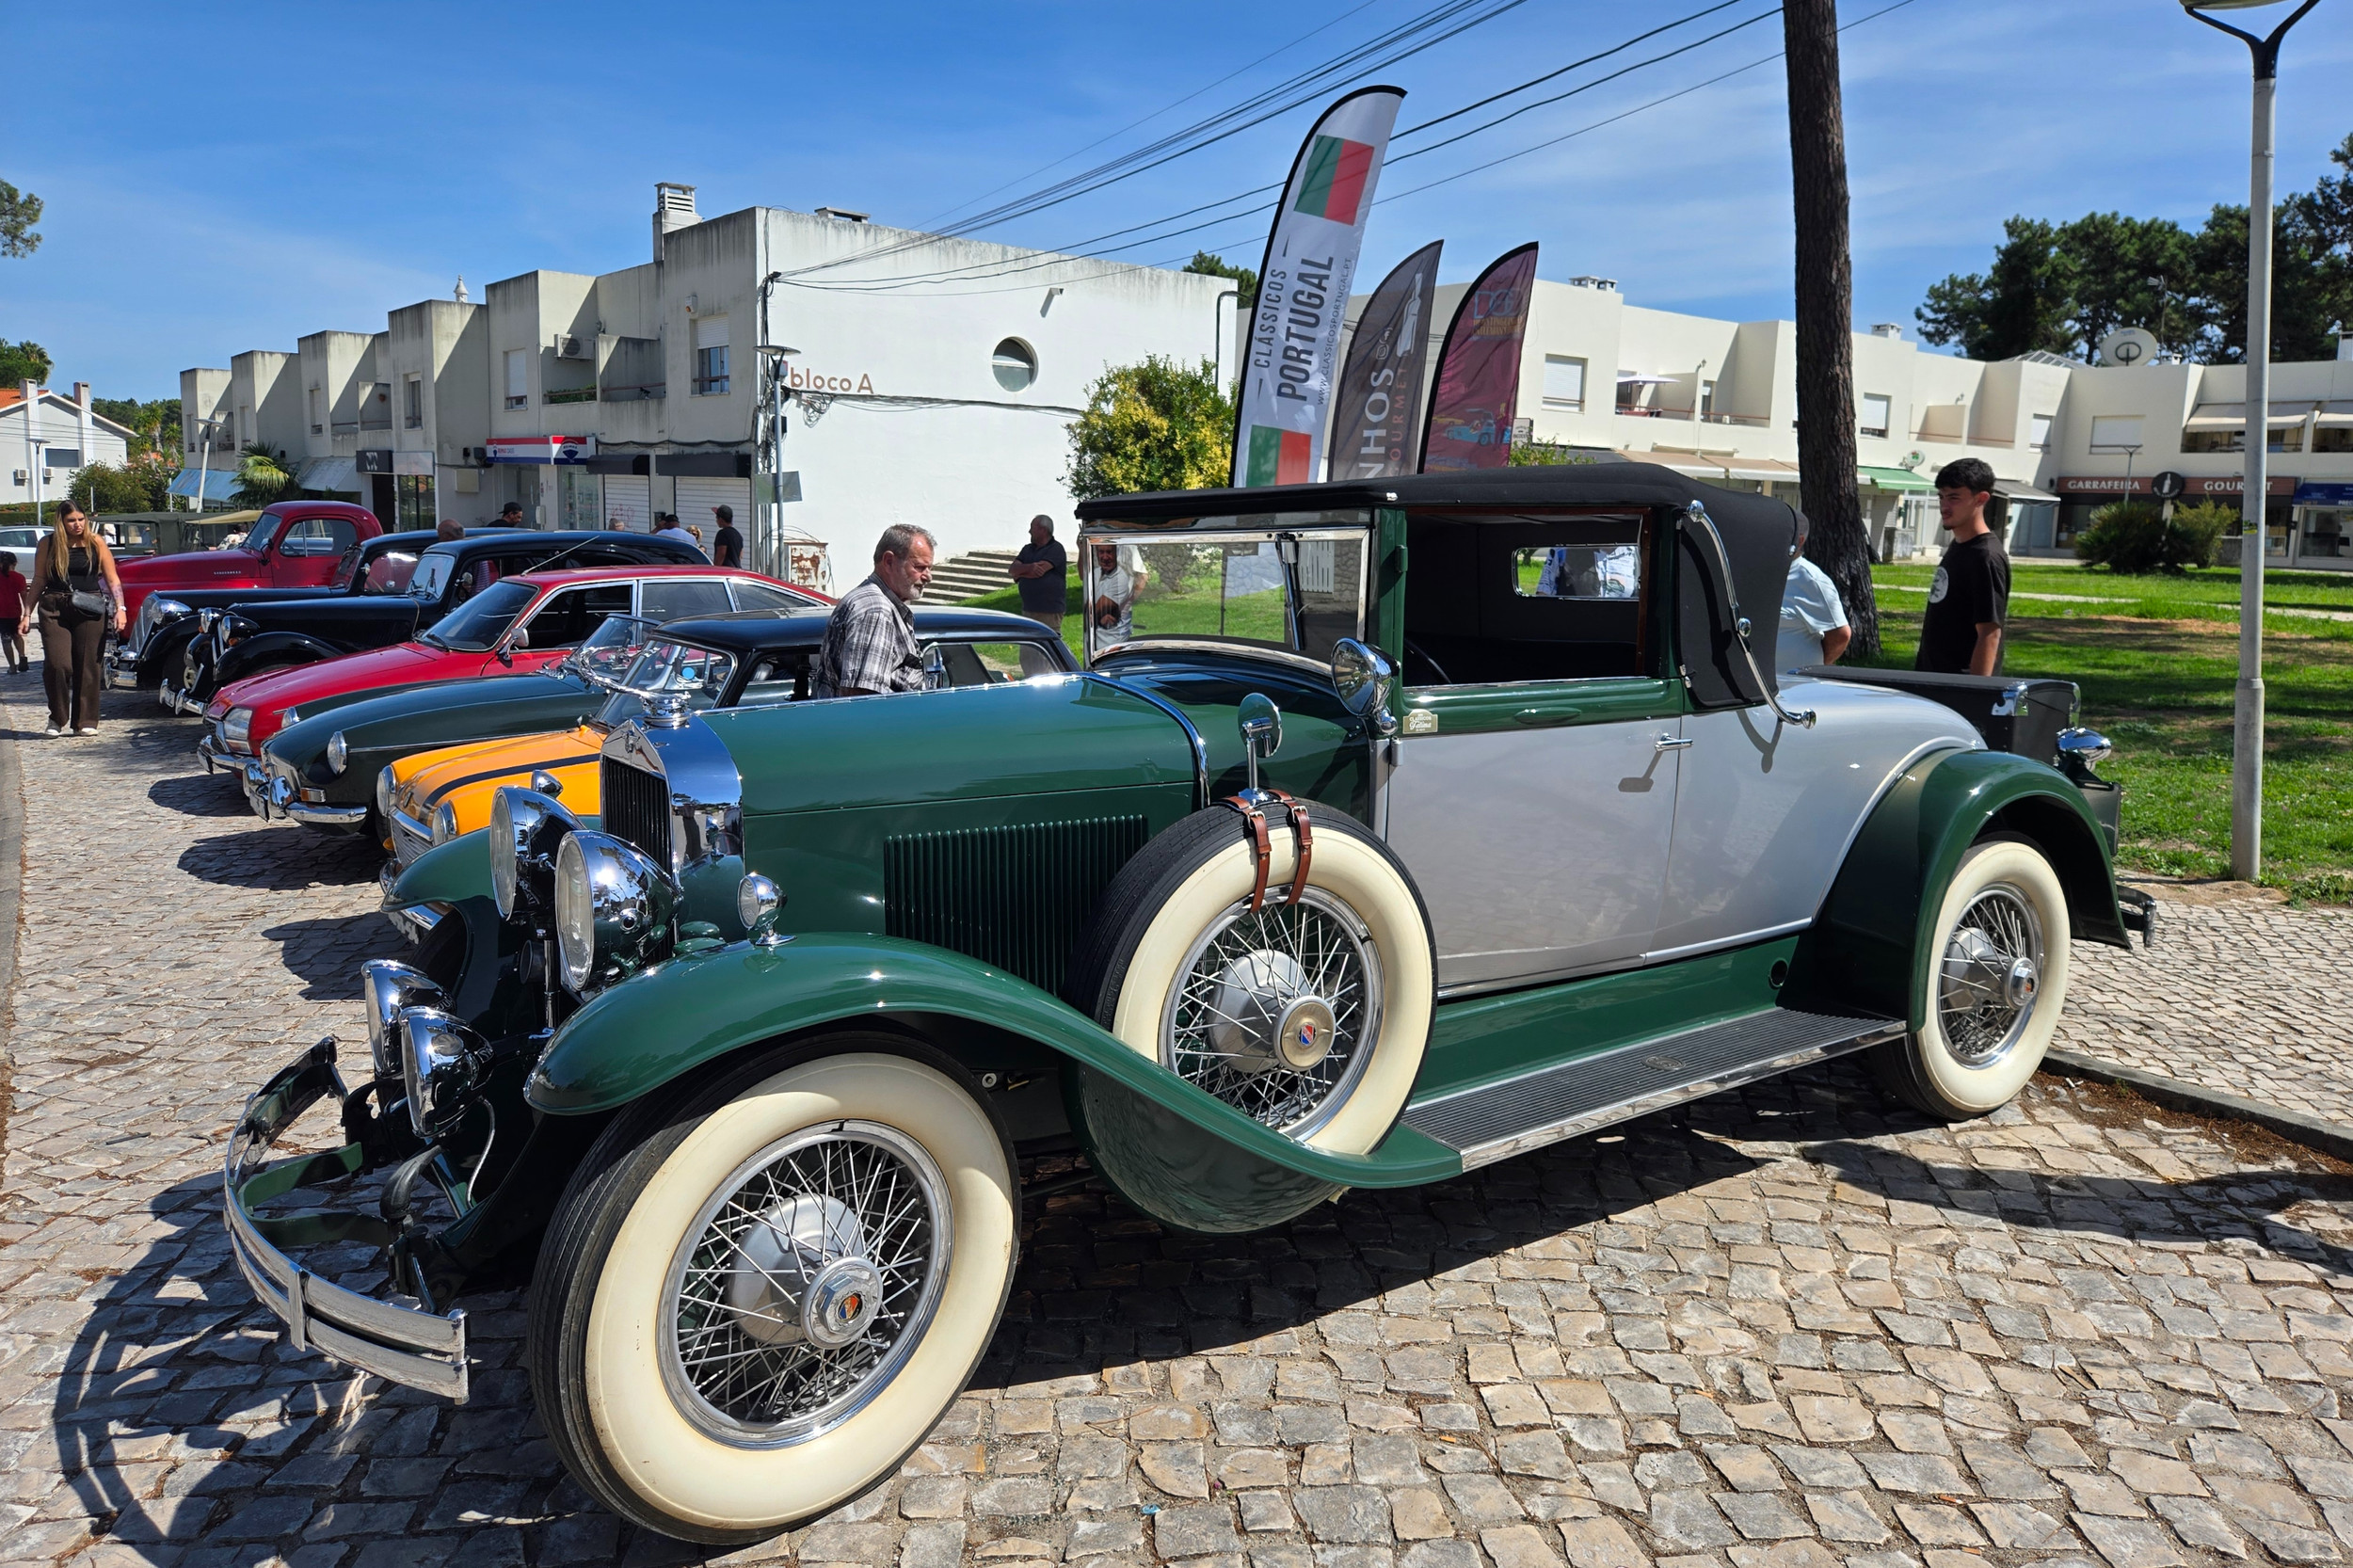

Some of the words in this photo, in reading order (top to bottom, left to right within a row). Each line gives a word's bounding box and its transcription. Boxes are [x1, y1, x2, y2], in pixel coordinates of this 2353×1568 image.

[1255, 268, 1287, 369] CLÁSSICOS
[1276, 256, 1334, 402] PORTUGAL
[790, 367, 852, 392] bloco
[857, 373, 874, 393] A
[2067, 480, 2140, 490] GARRAFEIRA
[2203, 481, 2273, 491] GOURT
